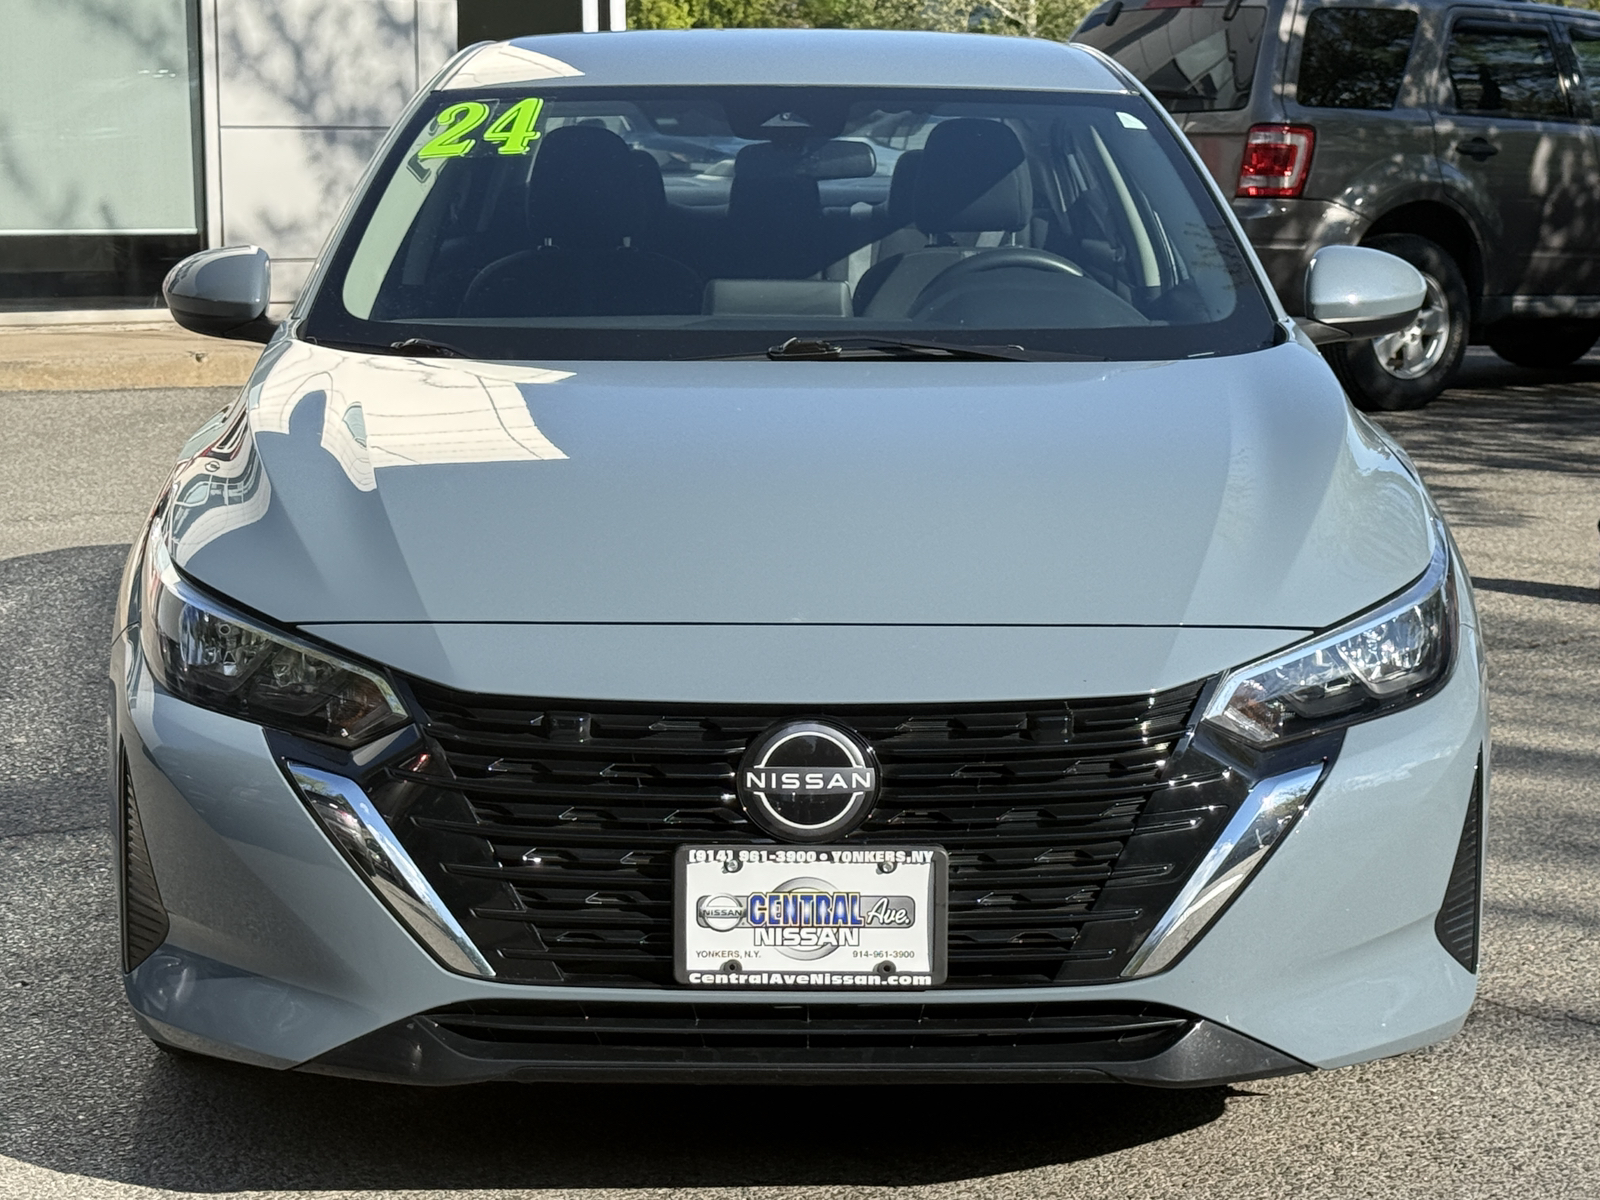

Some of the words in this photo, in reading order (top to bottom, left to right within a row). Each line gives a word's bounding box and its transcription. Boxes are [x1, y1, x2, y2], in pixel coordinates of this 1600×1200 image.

[418, 97, 544, 159] 24
[746, 771, 872, 790] NISSAN
[739, 850, 817, 863] 961-3900
[702, 909, 743, 917] NISSAN
[747, 892, 866, 928] CENTRAL
[866, 896, 912, 926] Ave.
[754, 927, 860, 947] NISSAN
[696, 950, 743, 959] YONKERS,
[744, 950, 762, 959] N.Y.
[852, 950, 915, 959] 914-961-3900
[688, 972, 933, 986] CentralAveNissan.com
